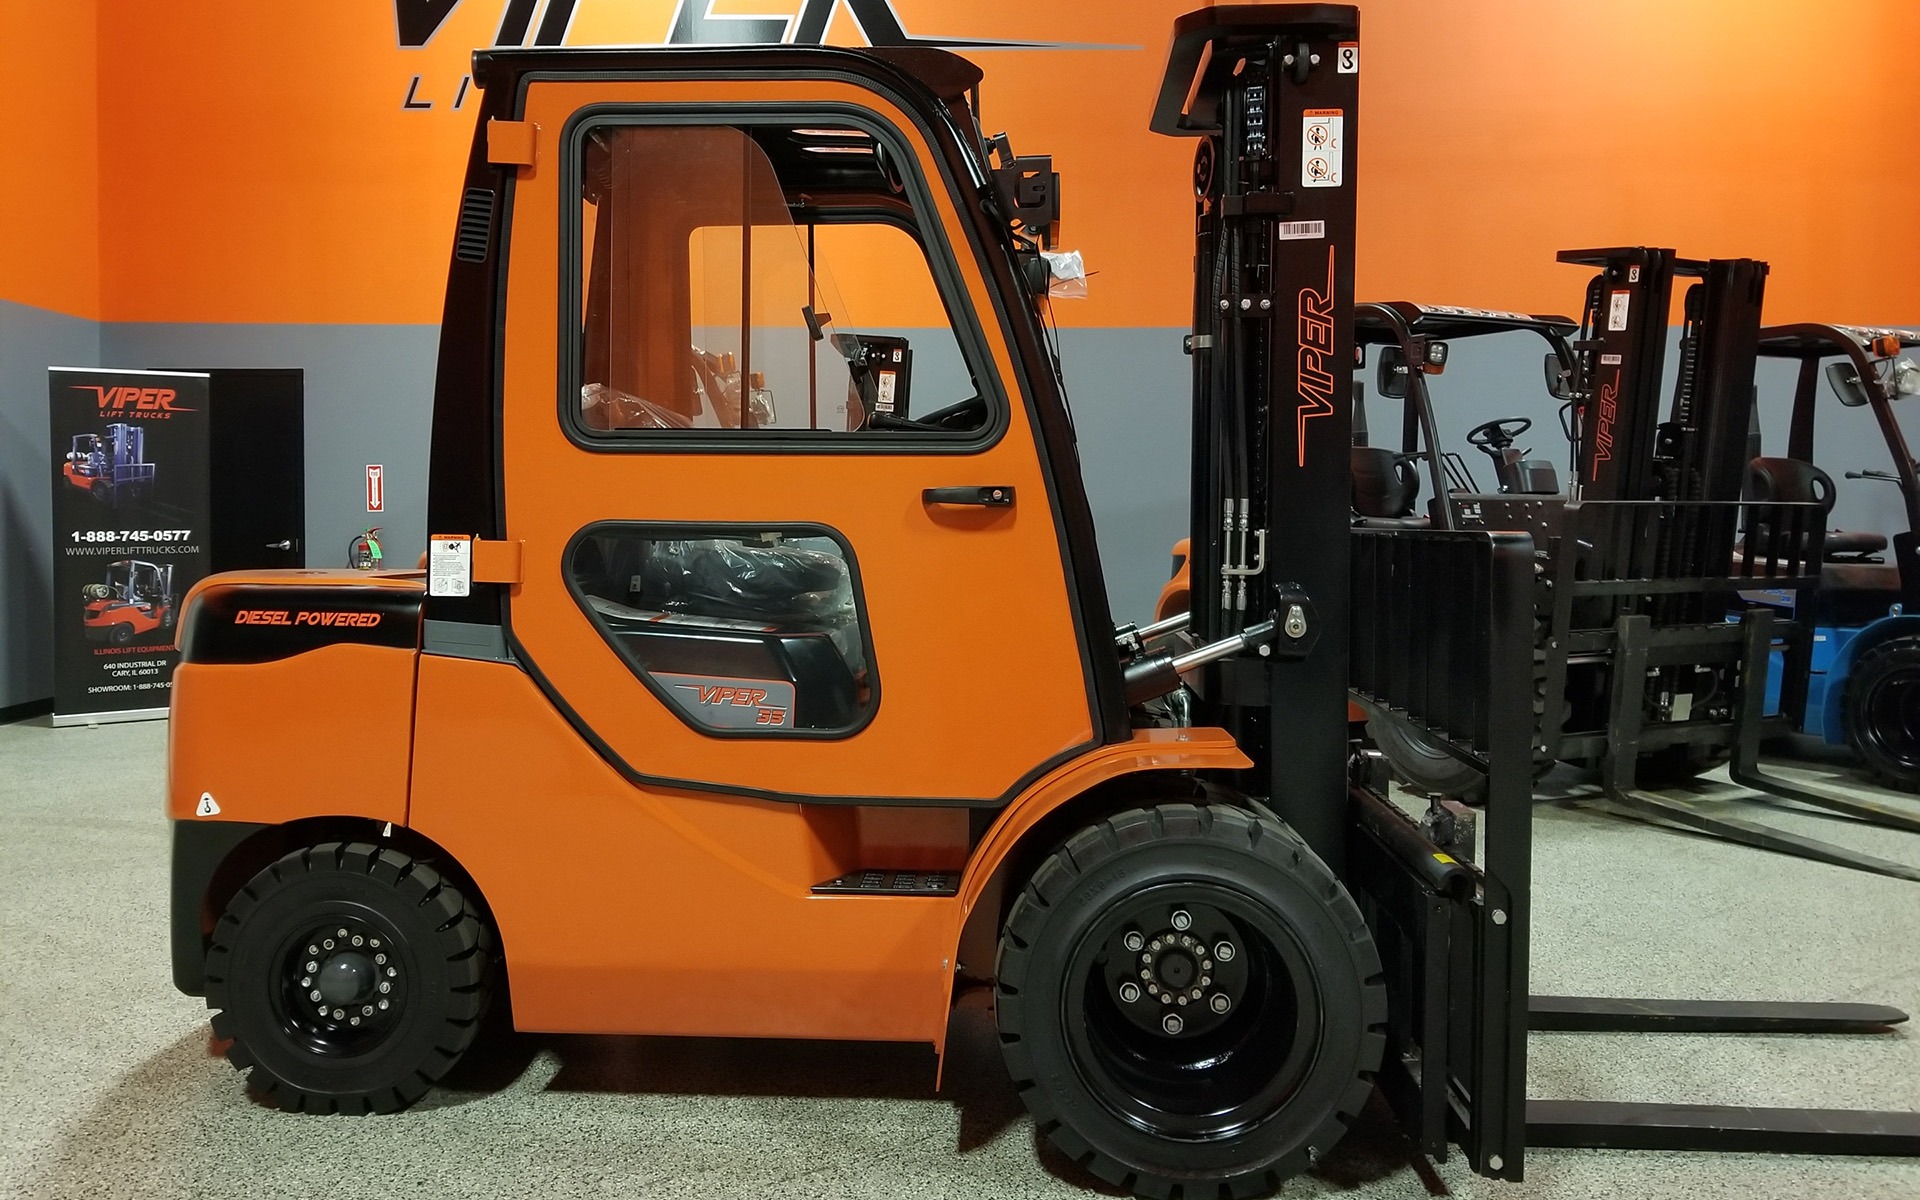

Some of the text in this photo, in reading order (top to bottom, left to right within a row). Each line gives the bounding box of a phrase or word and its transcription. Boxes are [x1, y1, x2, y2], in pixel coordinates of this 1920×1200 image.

[401, 75, 471, 110] LI
[1298, 244, 1334, 467] VIPER
[69, 385, 199, 411] VIPER
[99, 410, 171, 419] LIFT TRUCKS
[71, 530, 191, 543] 1-888-745-0577
[65, 545, 200, 556] WWW.VIPERLIFTTRUCKS.COM
[235, 611, 381, 627] DIESEL POWERED
[88, 682, 172, 693] SHOWROOM: 1-888-745-05
[674, 684, 787, 709] VIPER
[756, 709, 786, 726] 35
